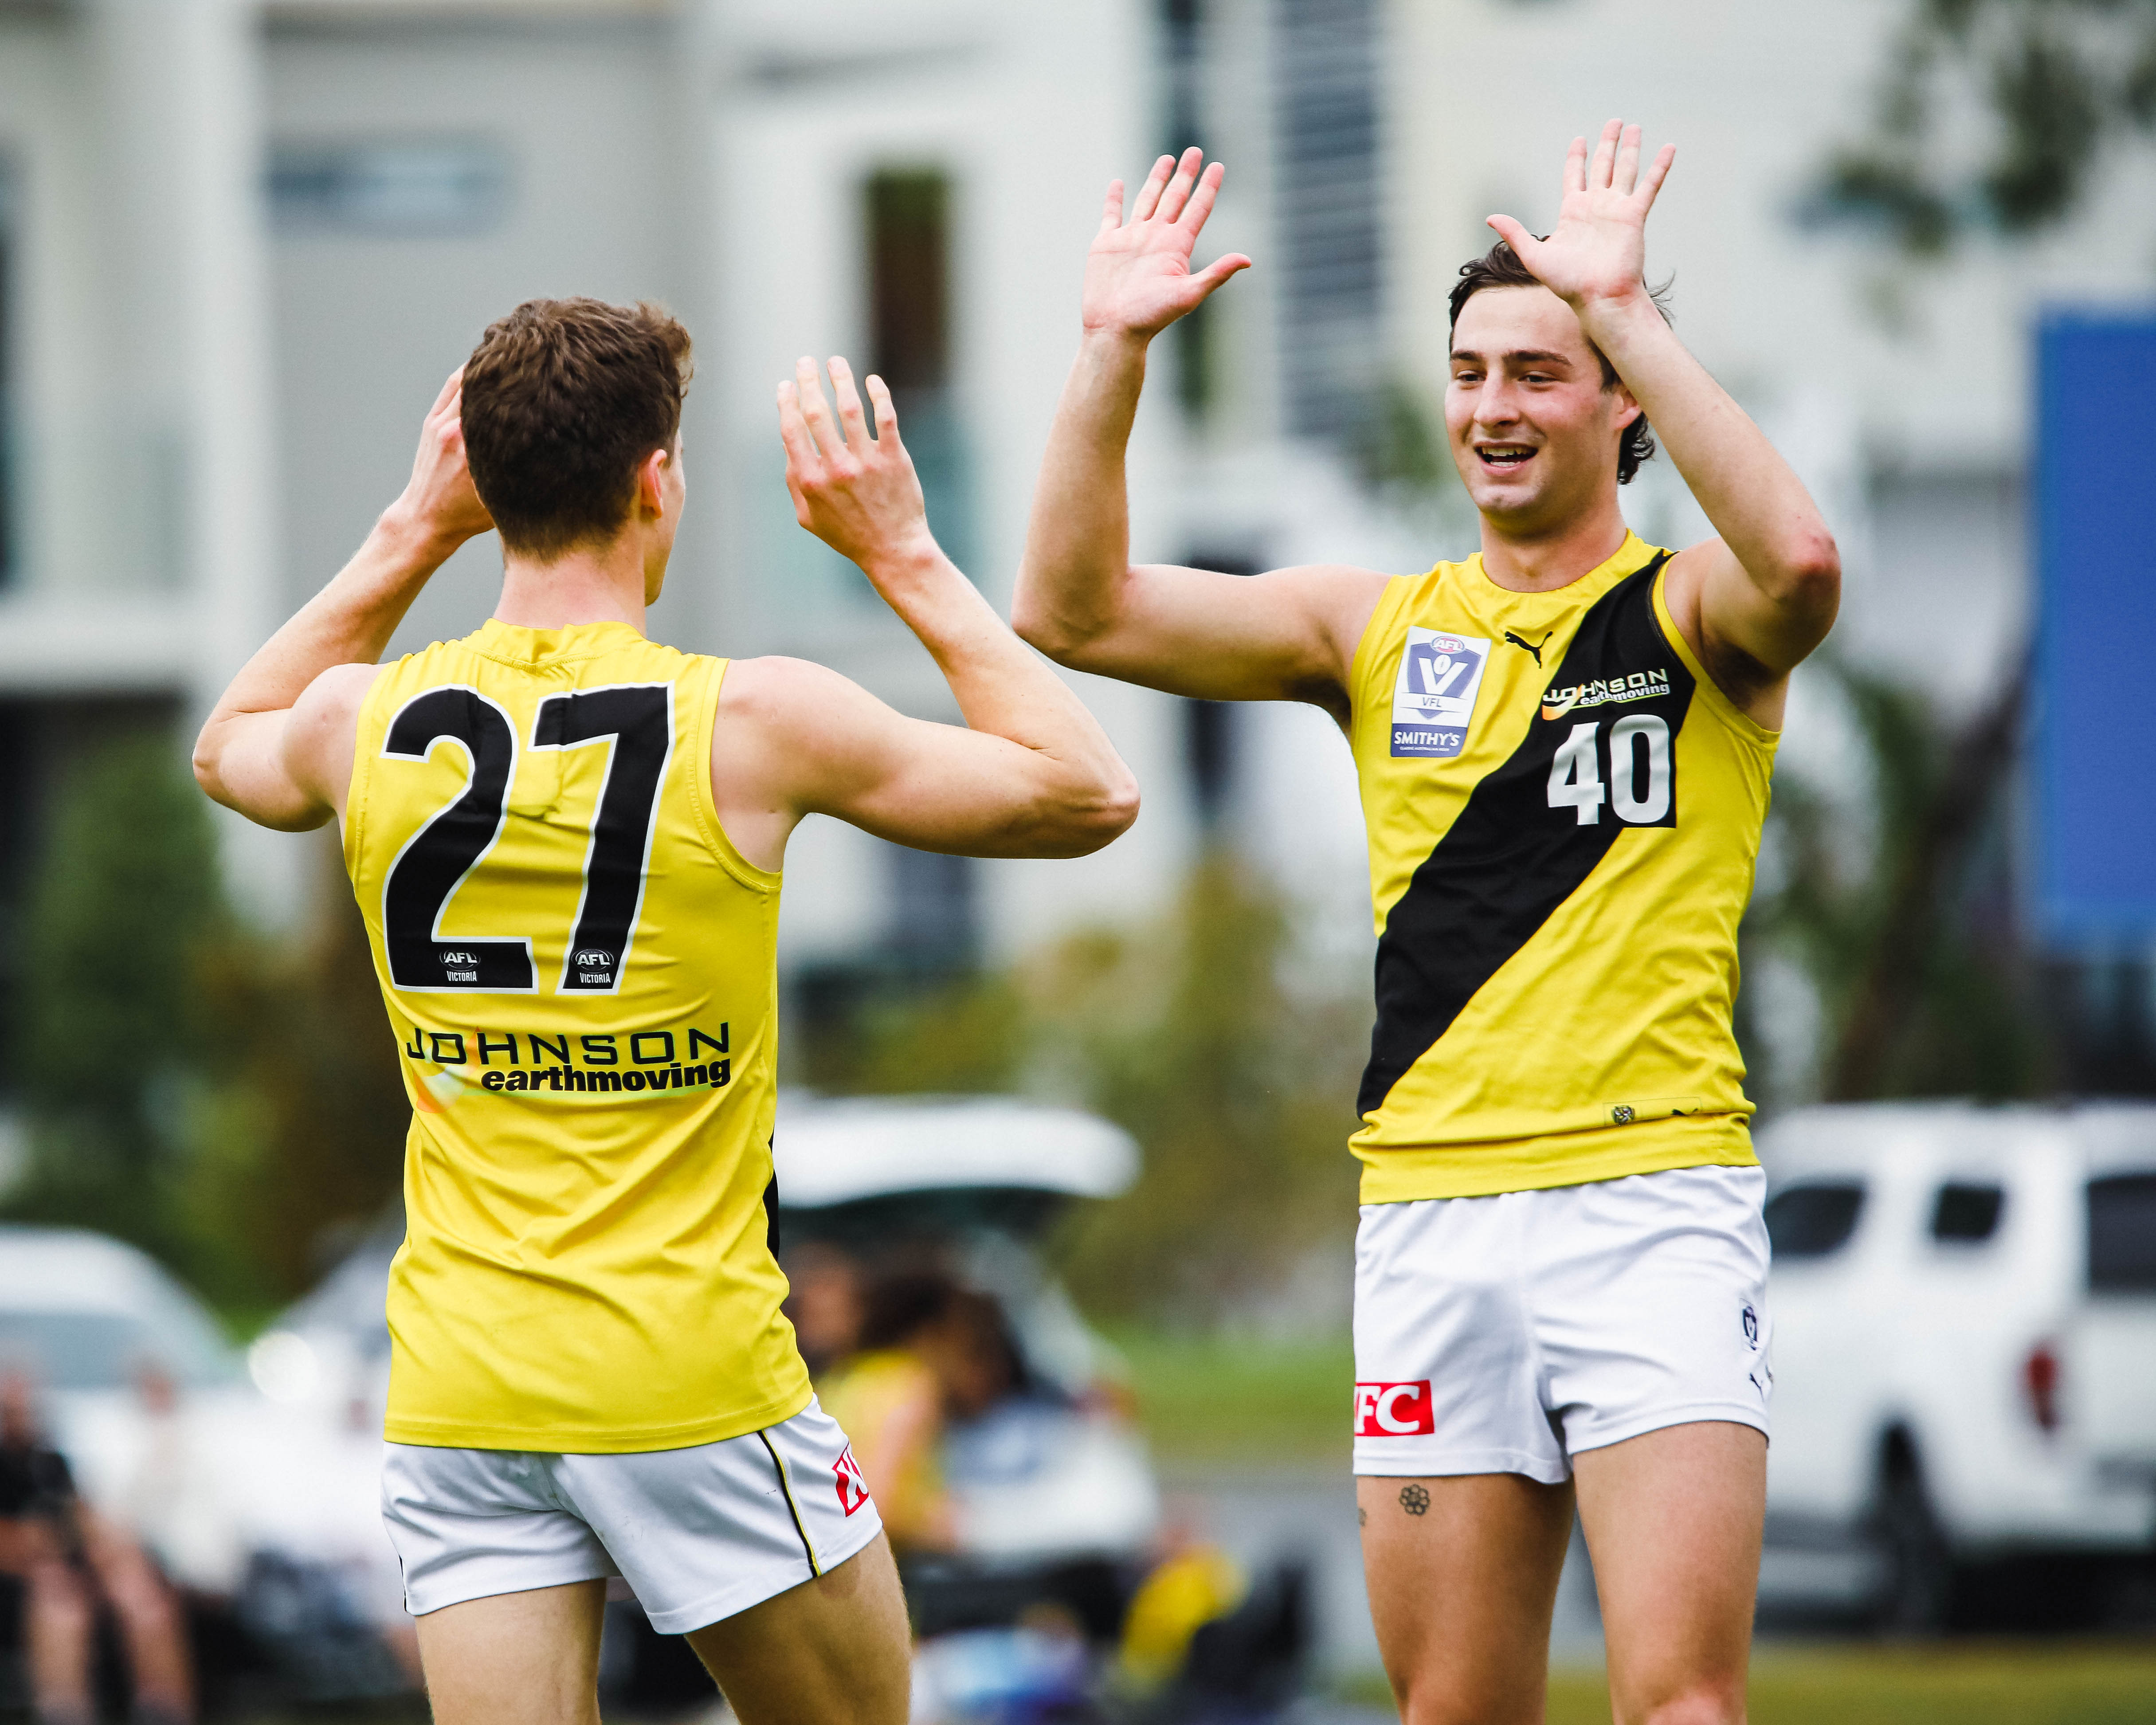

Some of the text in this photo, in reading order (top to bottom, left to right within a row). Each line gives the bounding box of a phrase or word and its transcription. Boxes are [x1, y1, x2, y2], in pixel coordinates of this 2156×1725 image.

[1432, 639, 1462, 651] AFL
[1542, 669, 1668, 702] JOHNSON
[1422, 697, 1442, 708] VFL
[1394, 731, 1460, 747] SMITHY'S
[1547, 714, 1670, 825] 40
[380, 680, 675, 995] 27
[444, 952, 478, 964] AFL
[577, 954, 611, 965] AFL
[447, 970, 477, 982] VICTORIA
[580, 972, 611, 984] VICTORIA
[406, 1022, 729, 1065] JOHNSON
[481, 1058, 731, 1092] earthmoving
[1354, 1384, 1420, 1434] FC
